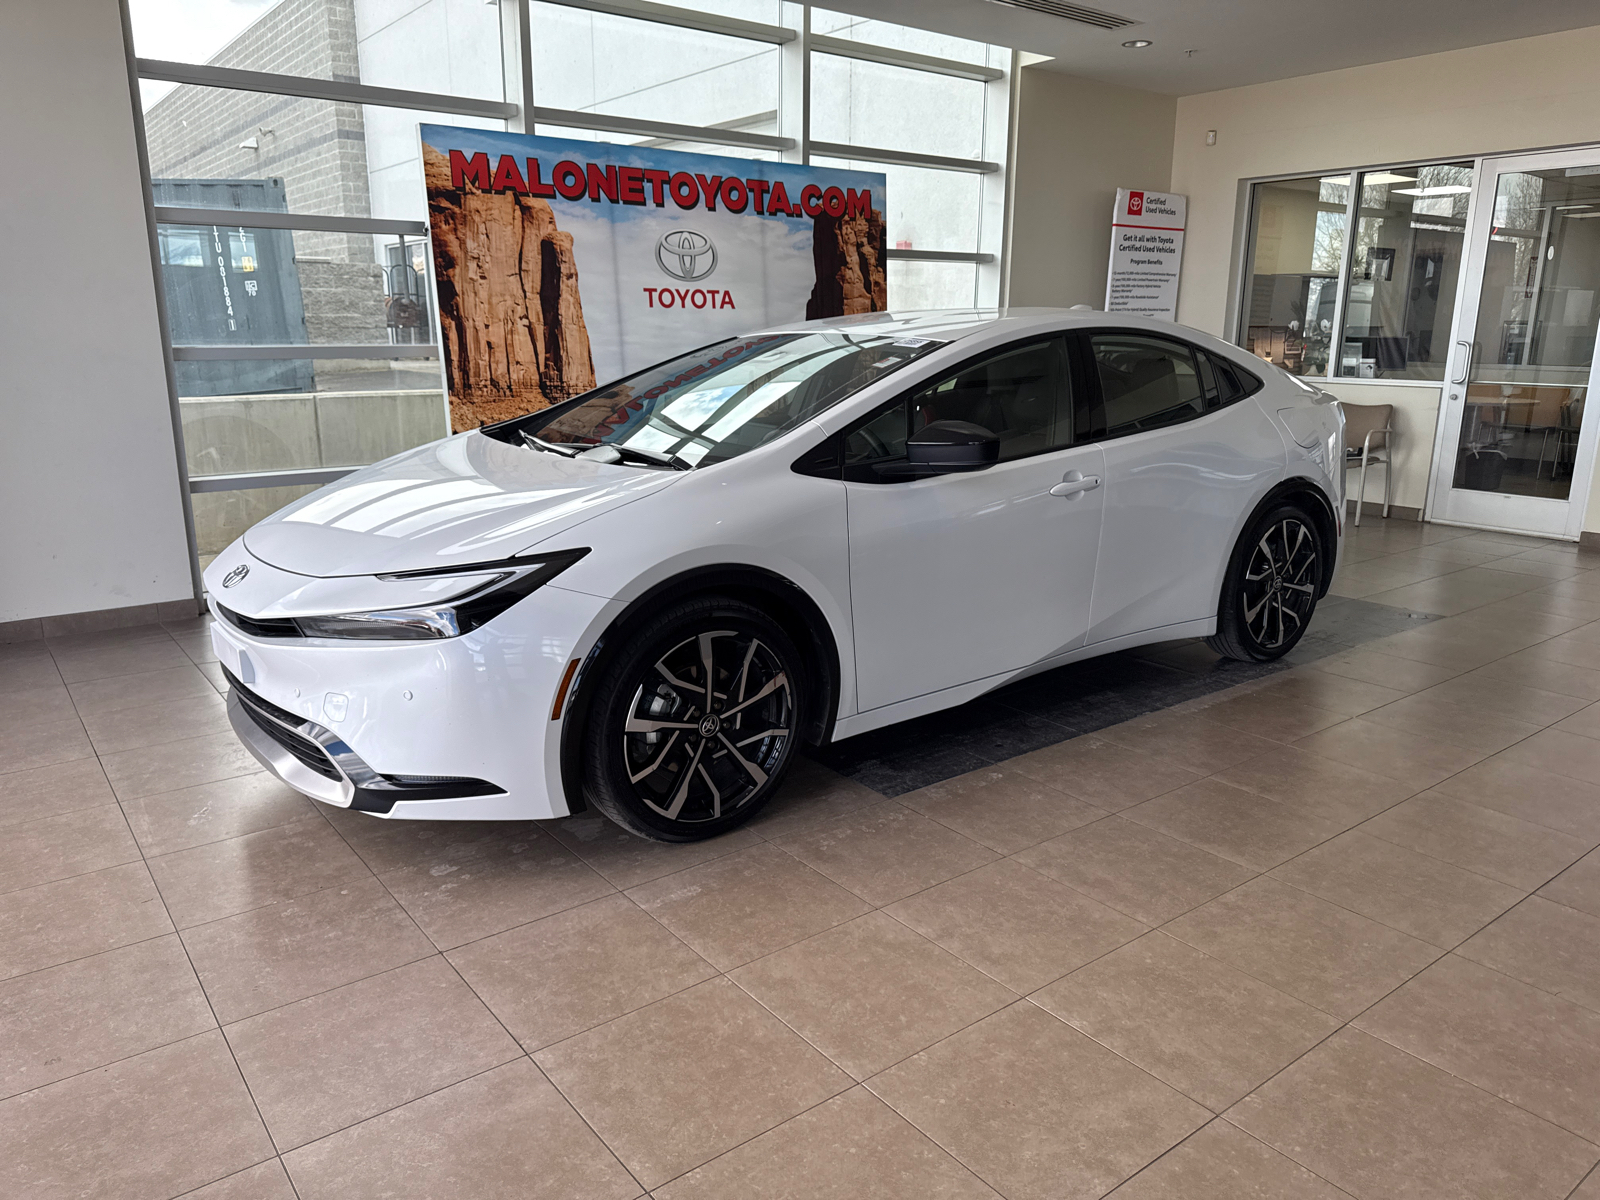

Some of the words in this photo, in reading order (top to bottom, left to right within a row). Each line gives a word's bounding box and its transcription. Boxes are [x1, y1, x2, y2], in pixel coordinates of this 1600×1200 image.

[448, 149, 873, 219] MALONETOYOTA.COM
[1146, 197, 1167, 206] Certified
[1145, 206, 1157, 214] Used
[1158, 207, 1177, 216] Vehicles
[1123, 234, 1133, 243] Get
[1145, 236, 1157, 244] with
[1157, 236, 1174, 245] Toyota
[1119, 244, 1142, 253] Certified
[1142, 245, 1155, 253] Used
[1156, 246, 1176, 254] Vehicles
[1130, 258, 1147, 266] Program
[642, 287, 736, 310] TOYOTA
